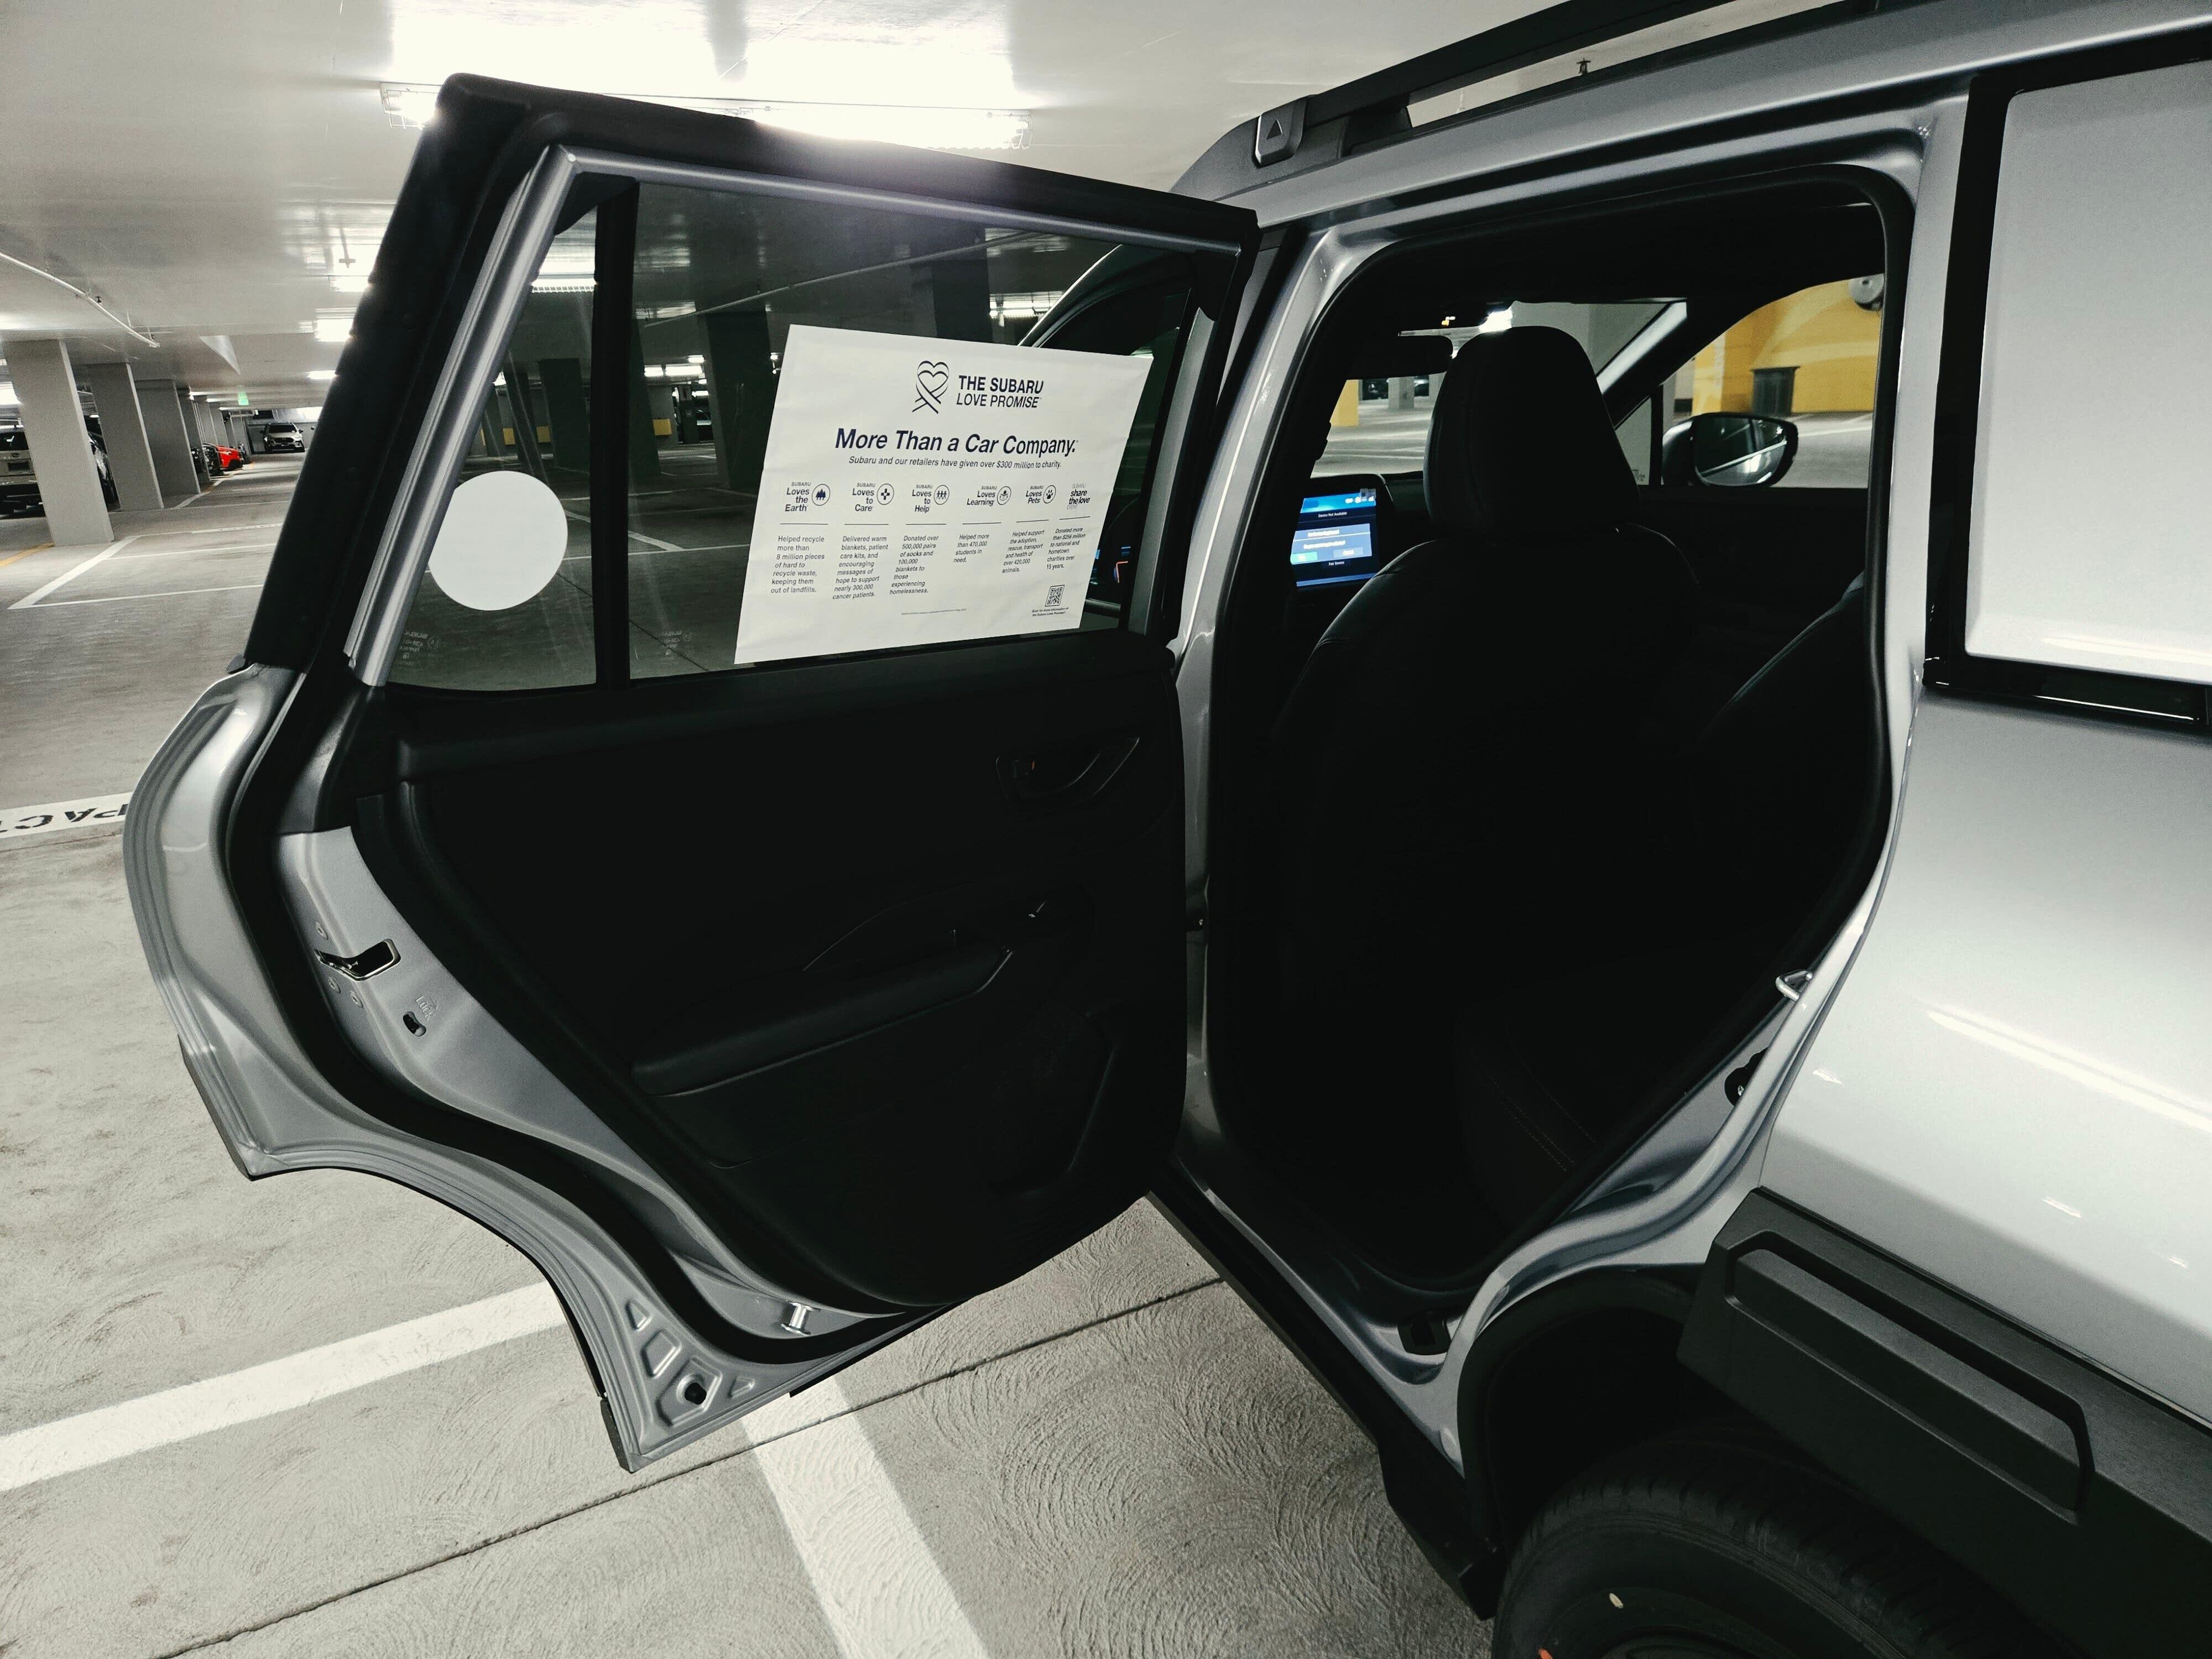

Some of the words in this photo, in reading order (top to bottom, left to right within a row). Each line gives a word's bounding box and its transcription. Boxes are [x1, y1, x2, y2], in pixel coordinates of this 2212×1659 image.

[958, 375, 986, 391] THE
[990, 377, 1044, 394] SUBARU
[956, 393, 987, 406] LOVE
[990, 394, 1041, 408] PROMISE
[835, 428, 888, 449] More
[895, 430, 942, 451] Than
[947, 437, 959, 451] a
[965, 434, 999, 453] Car
[1003, 435, 1077, 458] Company.
[849, 456, 877, 465] Subaru
[878, 456, 894, 465] and
[909, 457, 939, 466] retailers
[940, 458, 958, 467] have
[959, 459, 978, 469] given
[996, 460, 1013, 469] $300
[1014, 461, 1034, 469] million
[1041, 461, 1061, 469] charity.
[852, 488, 874, 496] Loves
[785, 504, 807, 512] Earth
[967, 498, 995, 507] Learning
[834, 585, 852, 593] nearly
